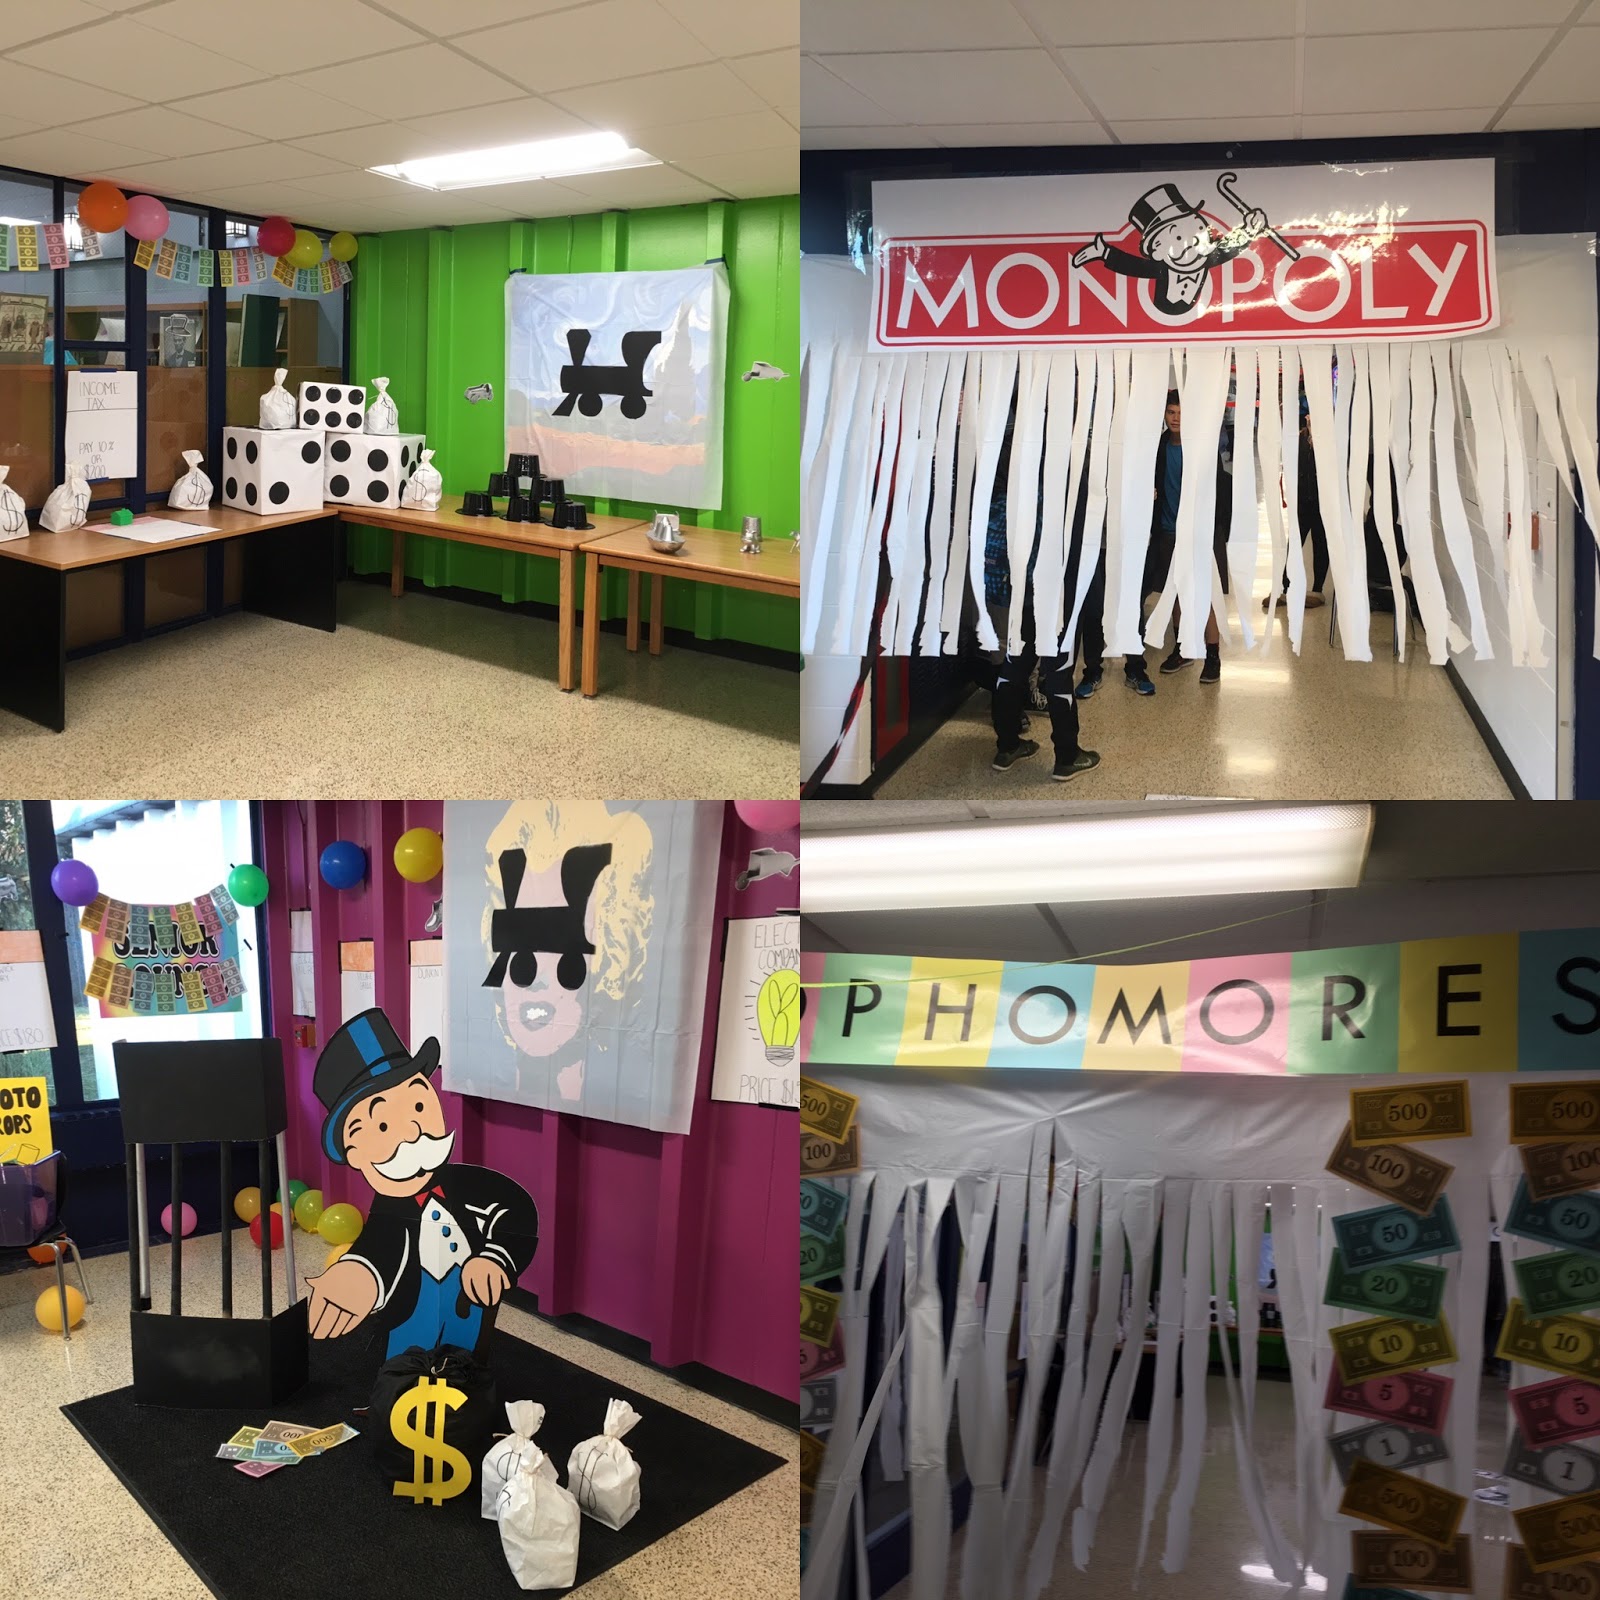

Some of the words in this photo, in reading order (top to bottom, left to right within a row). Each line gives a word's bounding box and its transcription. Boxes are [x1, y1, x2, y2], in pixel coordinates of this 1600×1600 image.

[896, 241, 1469, 330] MONOPOLY
[79, 381, 121, 396] INCOME
[86, 398, 106, 410] TAX
[79, 442, 94, 454] PAY
[98, 441, 115, 452] 10%
[91, 454, 103, 465] OR
[84, 464, 106, 478] $200
[754, 921, 800, 948] ELECT
[800, 956, 1600, 1046] PHOMORES
[0, 1086, 42, 1110] OTO
[739, 1074, 777, 1104] PRICE
[1388, 1102, 1428, 1122] 500
[1551, 1100, 1595, 1119] 500
[0, 1113, 32, 1136] OPS
[804, 1142, 831, 1160] 100
[1566, 1147, 1600, 1172] 100
[1368, 1153, 1405, 1180] 100
[1559, 1208, 1591, 1230] 50
[1381, 1222, 1408, 1244] 50
[1370, 1274, 1398, 1295] 20
[1567, 1265, 1599, 1289] 20
[1379, 1333, 1403, 1355] 10
[1554, 1332, 1580, 1353] 10
[1379, 1383, 1392, 1401] 5
[1574, 1396, 1589, 1415] 5
[1380, 1438, 1394, 1457] 1
[1560, 1461, 1575, 1481] 1
[1380, 1487, 1419, 1514] 500
[1392, 1549, 1431, 1568] 100
[1551, 1572, 1592, 1595] 100
